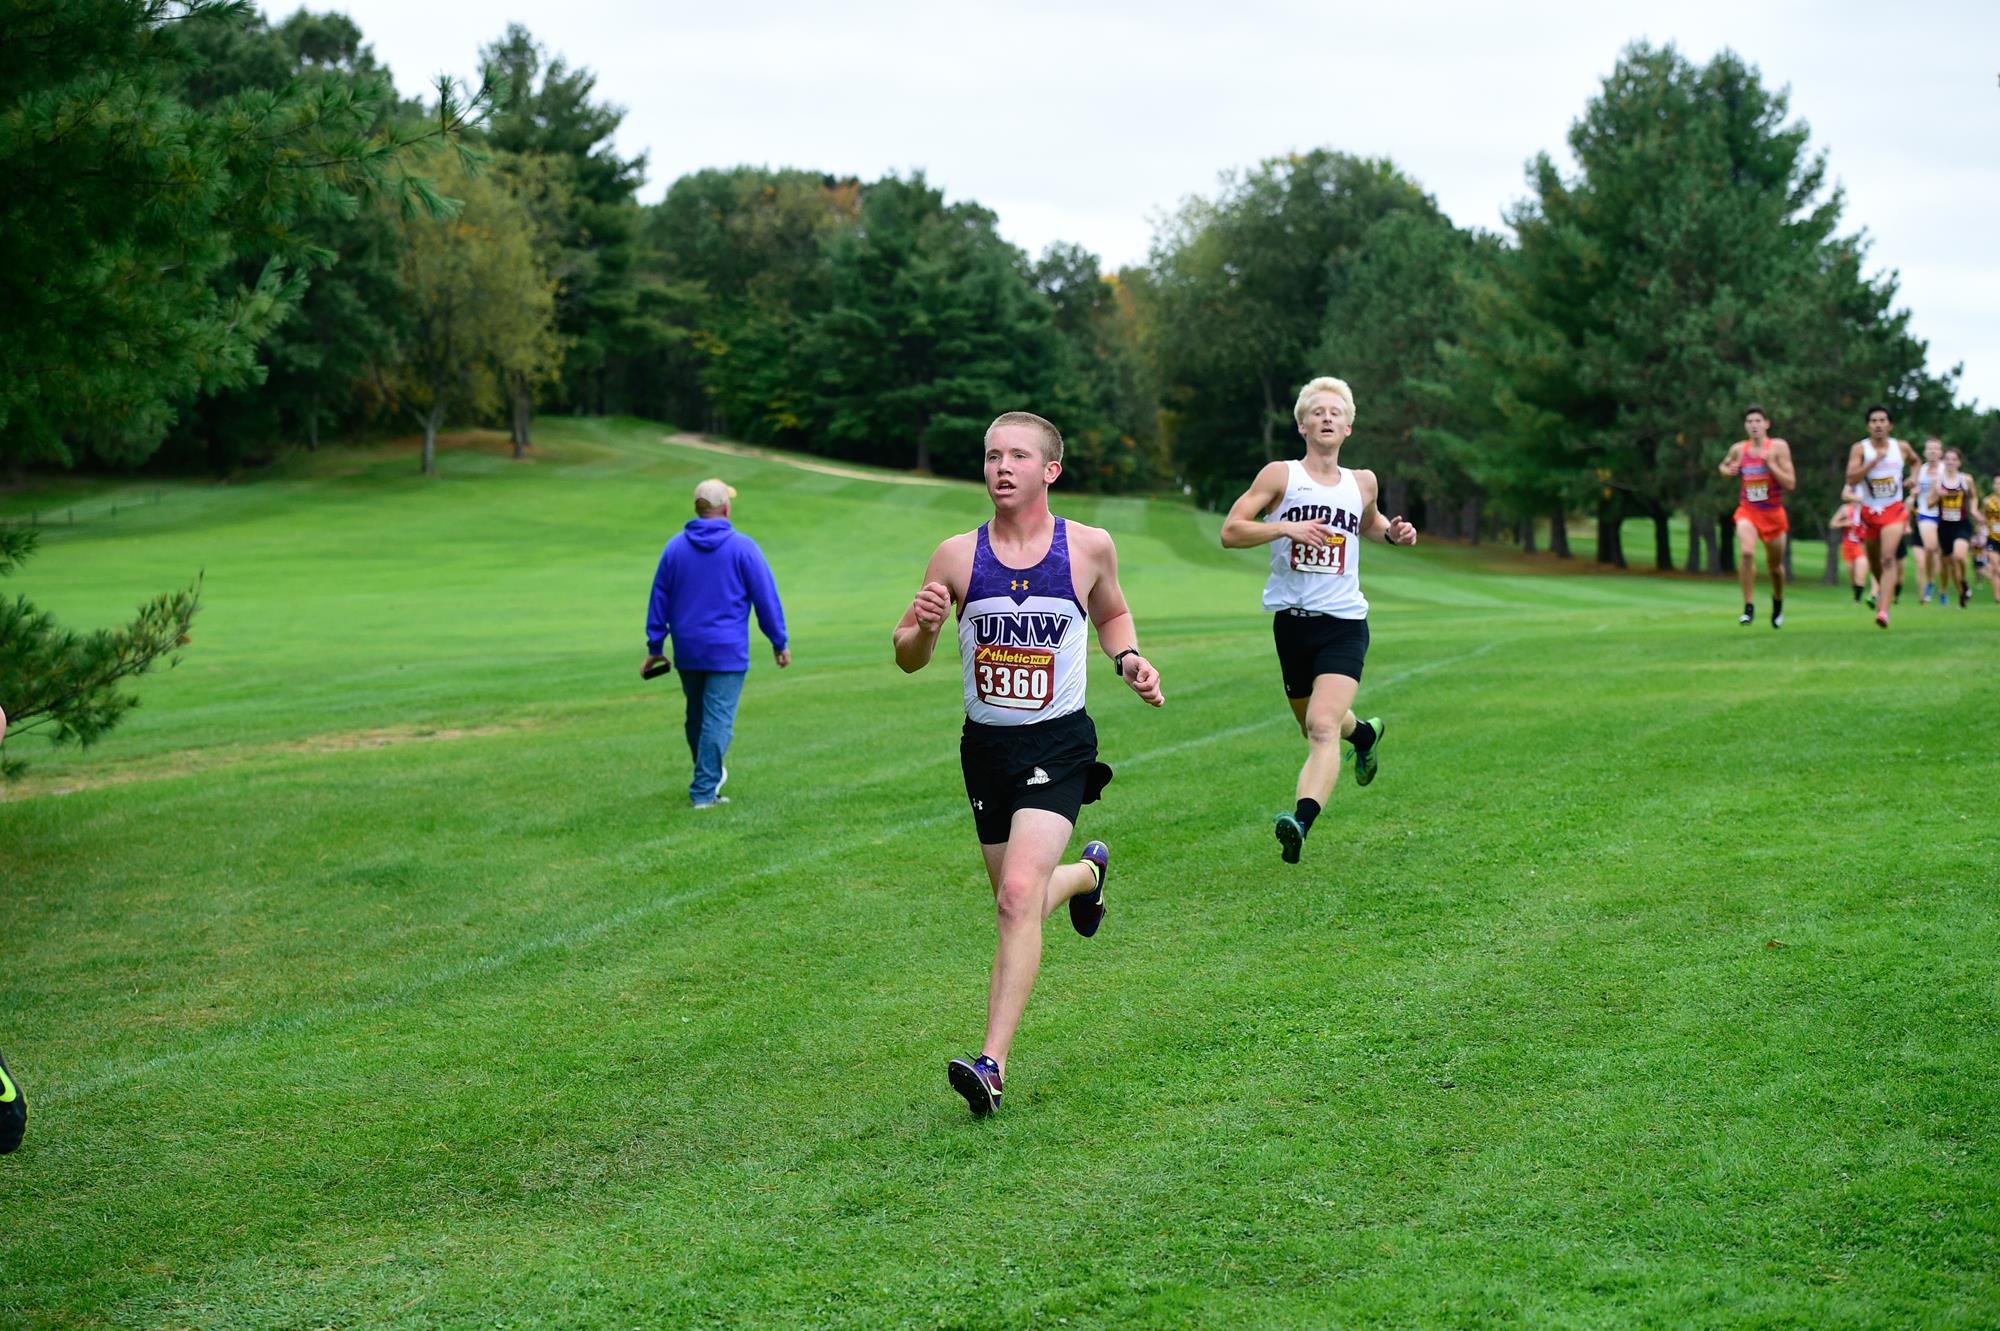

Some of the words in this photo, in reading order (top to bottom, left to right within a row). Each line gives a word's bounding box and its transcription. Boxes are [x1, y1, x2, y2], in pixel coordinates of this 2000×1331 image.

[1294, 543, 1341, 567] 3331
[969, 612, 1073, 648] UNW
[977, 647, 1031, 664] Athletic
[979, 665, 1048, 698] 3360
